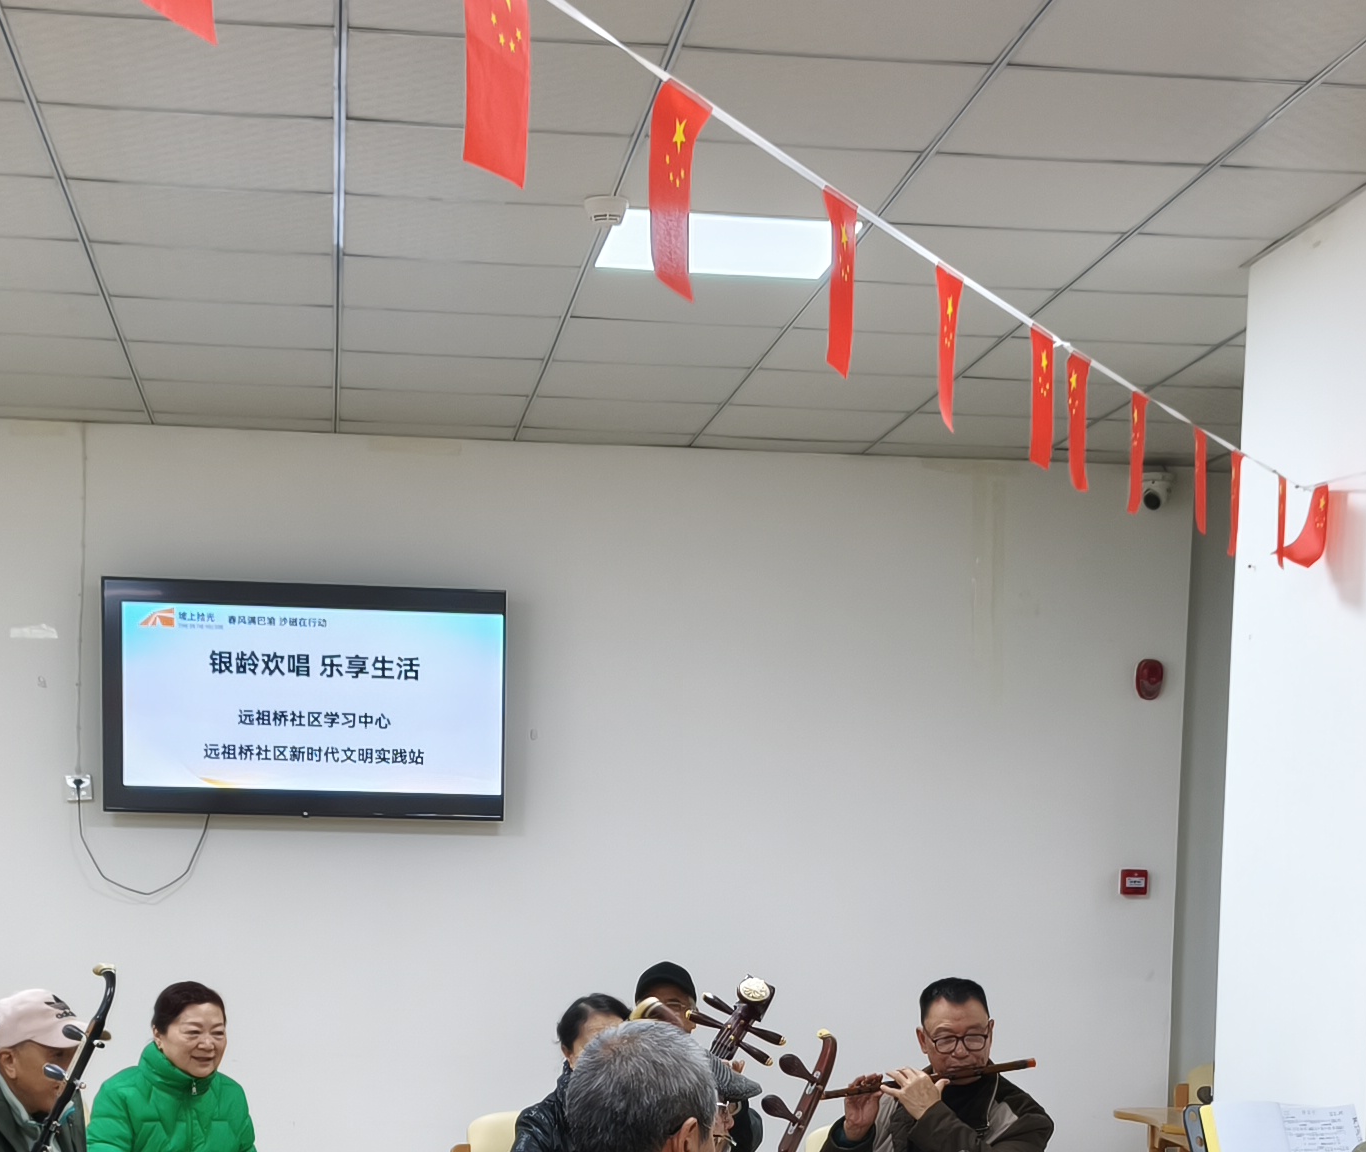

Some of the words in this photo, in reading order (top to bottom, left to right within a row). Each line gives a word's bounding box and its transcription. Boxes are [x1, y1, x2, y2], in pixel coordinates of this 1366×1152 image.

[209, 650, 311, 677] 银龄欢唱
[320, 654, 420, 681] 乐享生活
[237, 709, 392, 729] 远祖桥社区学习中心
[203, 743, 425, 765] 远祖桥社区新时代文明实践站
